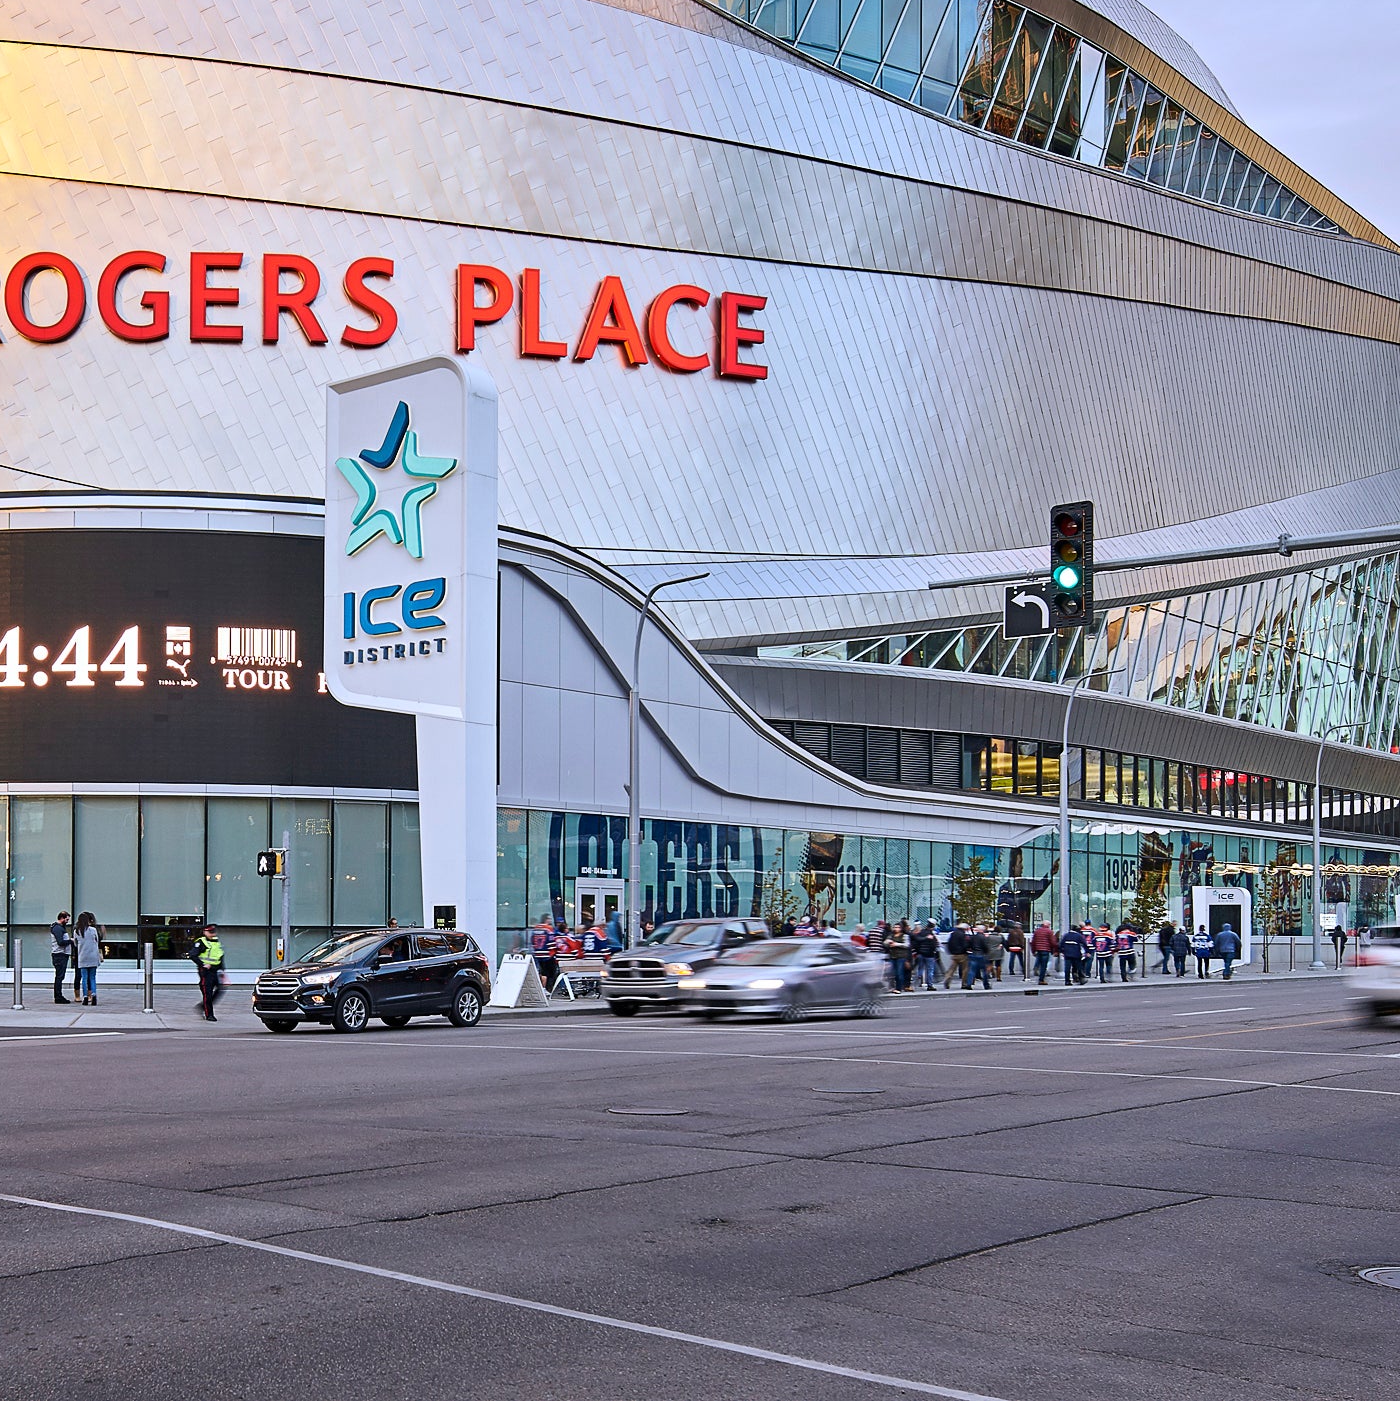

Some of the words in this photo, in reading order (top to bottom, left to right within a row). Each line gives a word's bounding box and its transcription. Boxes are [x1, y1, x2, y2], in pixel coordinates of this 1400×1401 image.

[456, 263, 768, 380] PLACE
[343, 637, 447, 665] DISTRICT
[222, 668, 291, 690] TOUR
[837, 864, 882, 905] 1984
[1106, 858, 1136, 891] 1985
